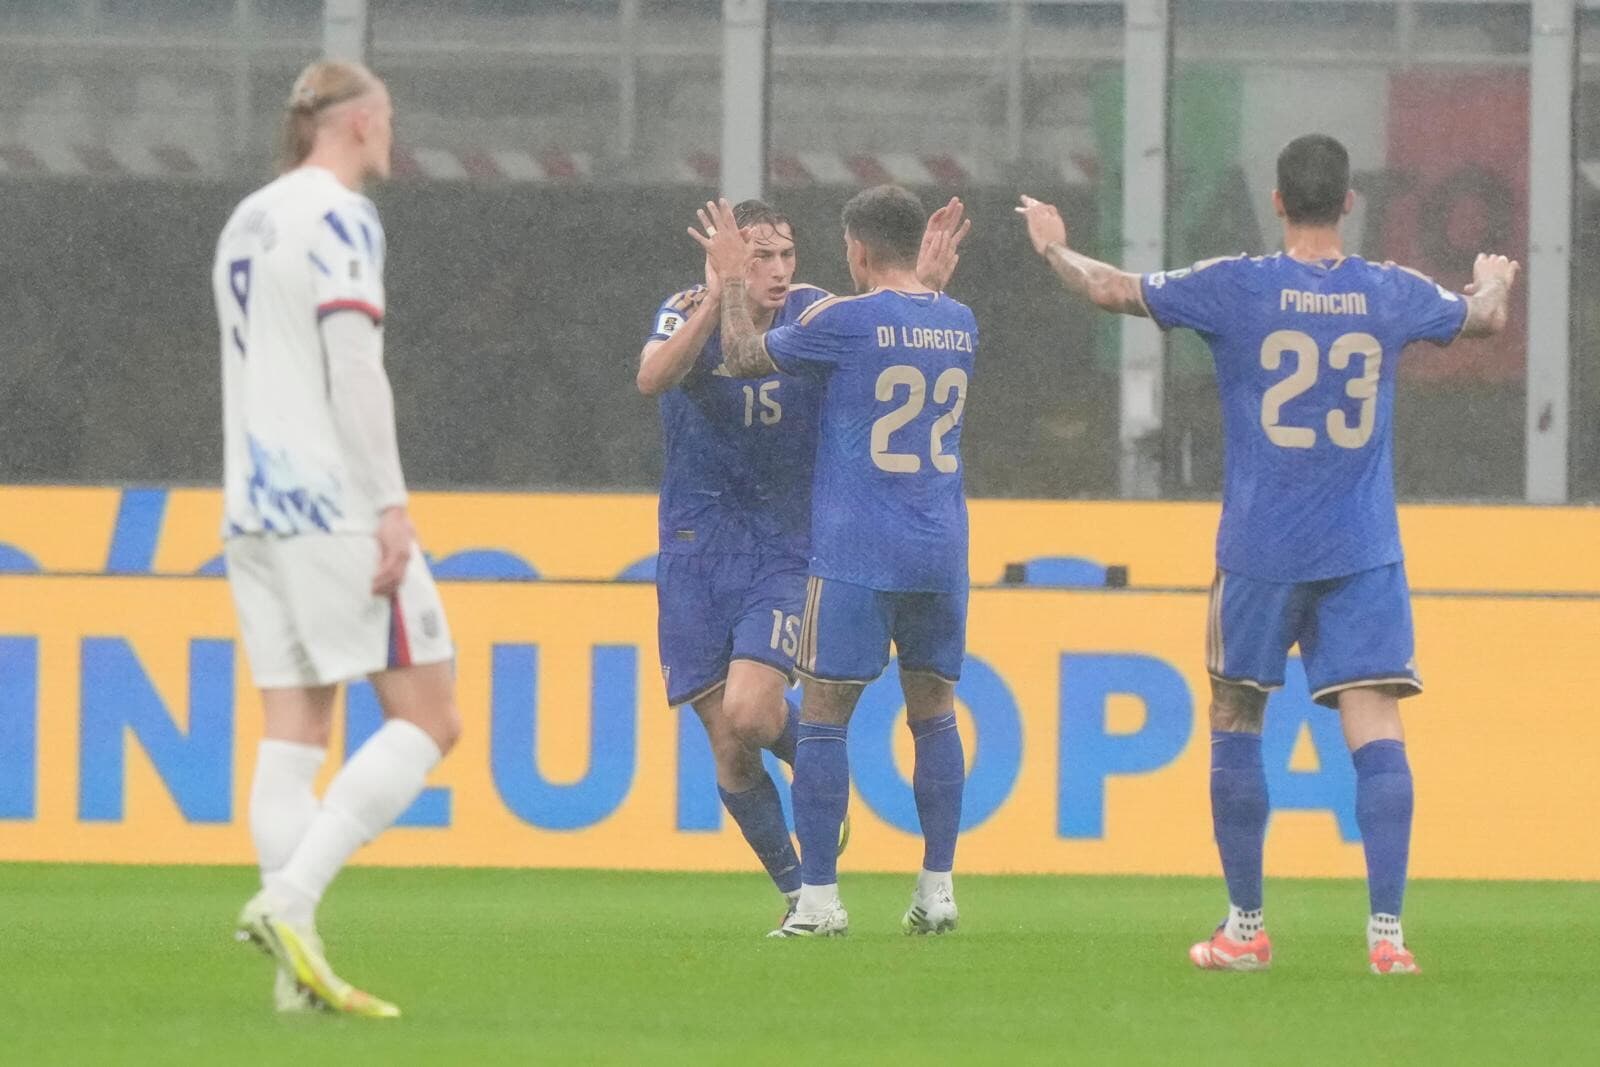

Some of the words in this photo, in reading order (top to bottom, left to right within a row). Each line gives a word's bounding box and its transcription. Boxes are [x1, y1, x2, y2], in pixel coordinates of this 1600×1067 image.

[229, 257, 251, 359] 9
[1280, 288, 1368, 315] MANCINI
[877, 326, 895, 347] DI
[902, 326, 972, 353] LORENZO
[742, 380, 782, 427] 15
[870, 365, 968, 473] 22
[1260, 329, 1383, 449] 23
